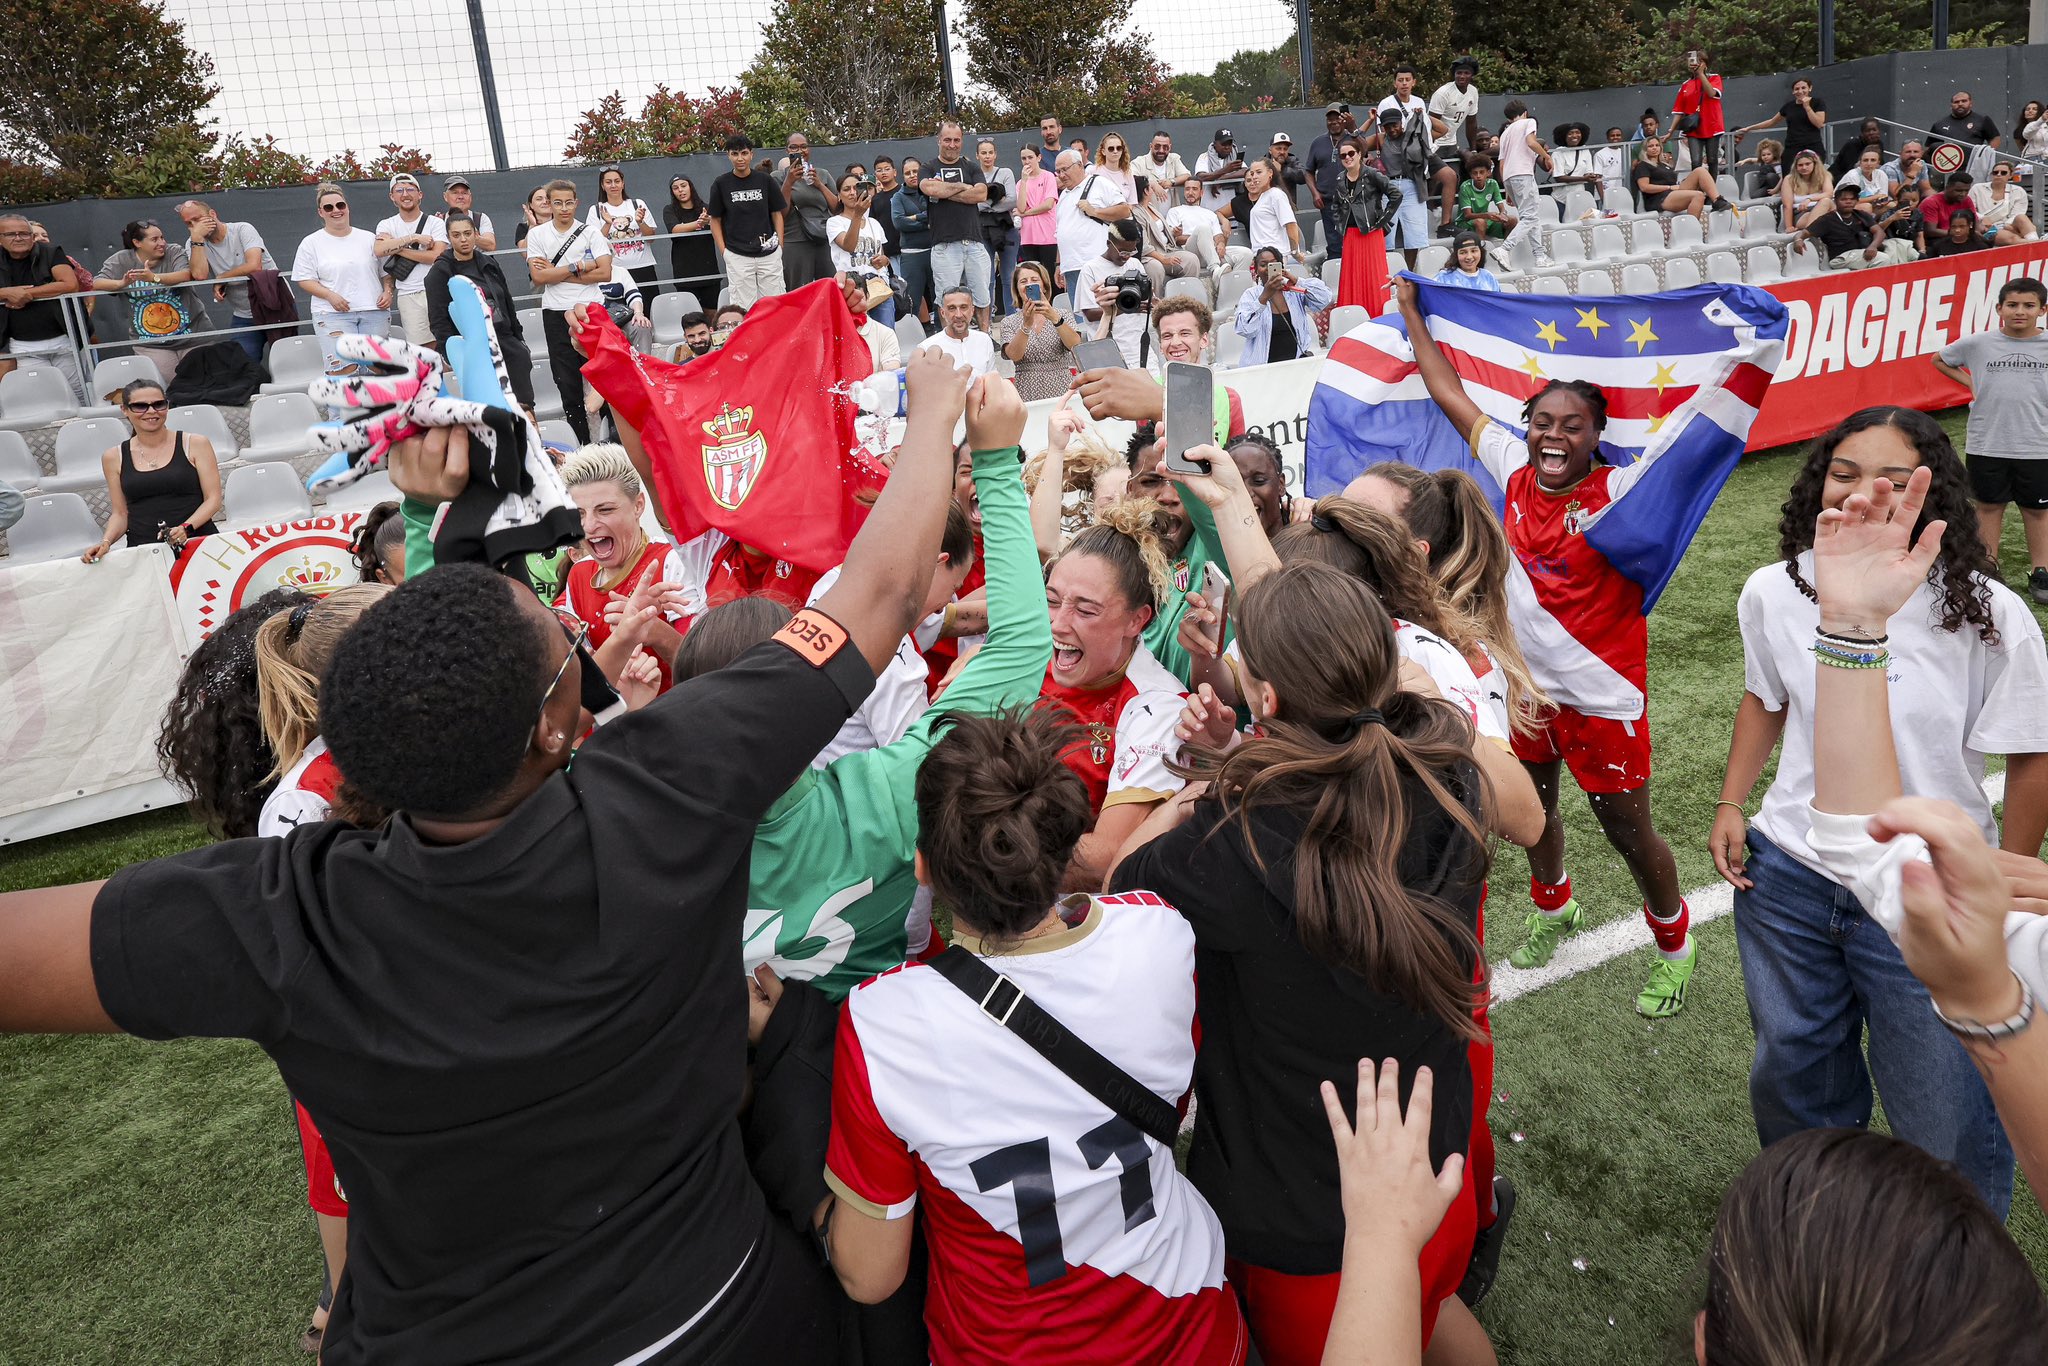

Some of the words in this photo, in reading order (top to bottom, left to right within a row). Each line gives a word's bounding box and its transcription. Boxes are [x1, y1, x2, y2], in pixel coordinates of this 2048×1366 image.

[1769, 274, 1956, 385] DAGHE
[711, 448, 740, 462] ASM
[742, 439, 758, 456] FF
[236, 512, 362, 551] RUGBY
[968, 1112, 1158, 1290] 11
